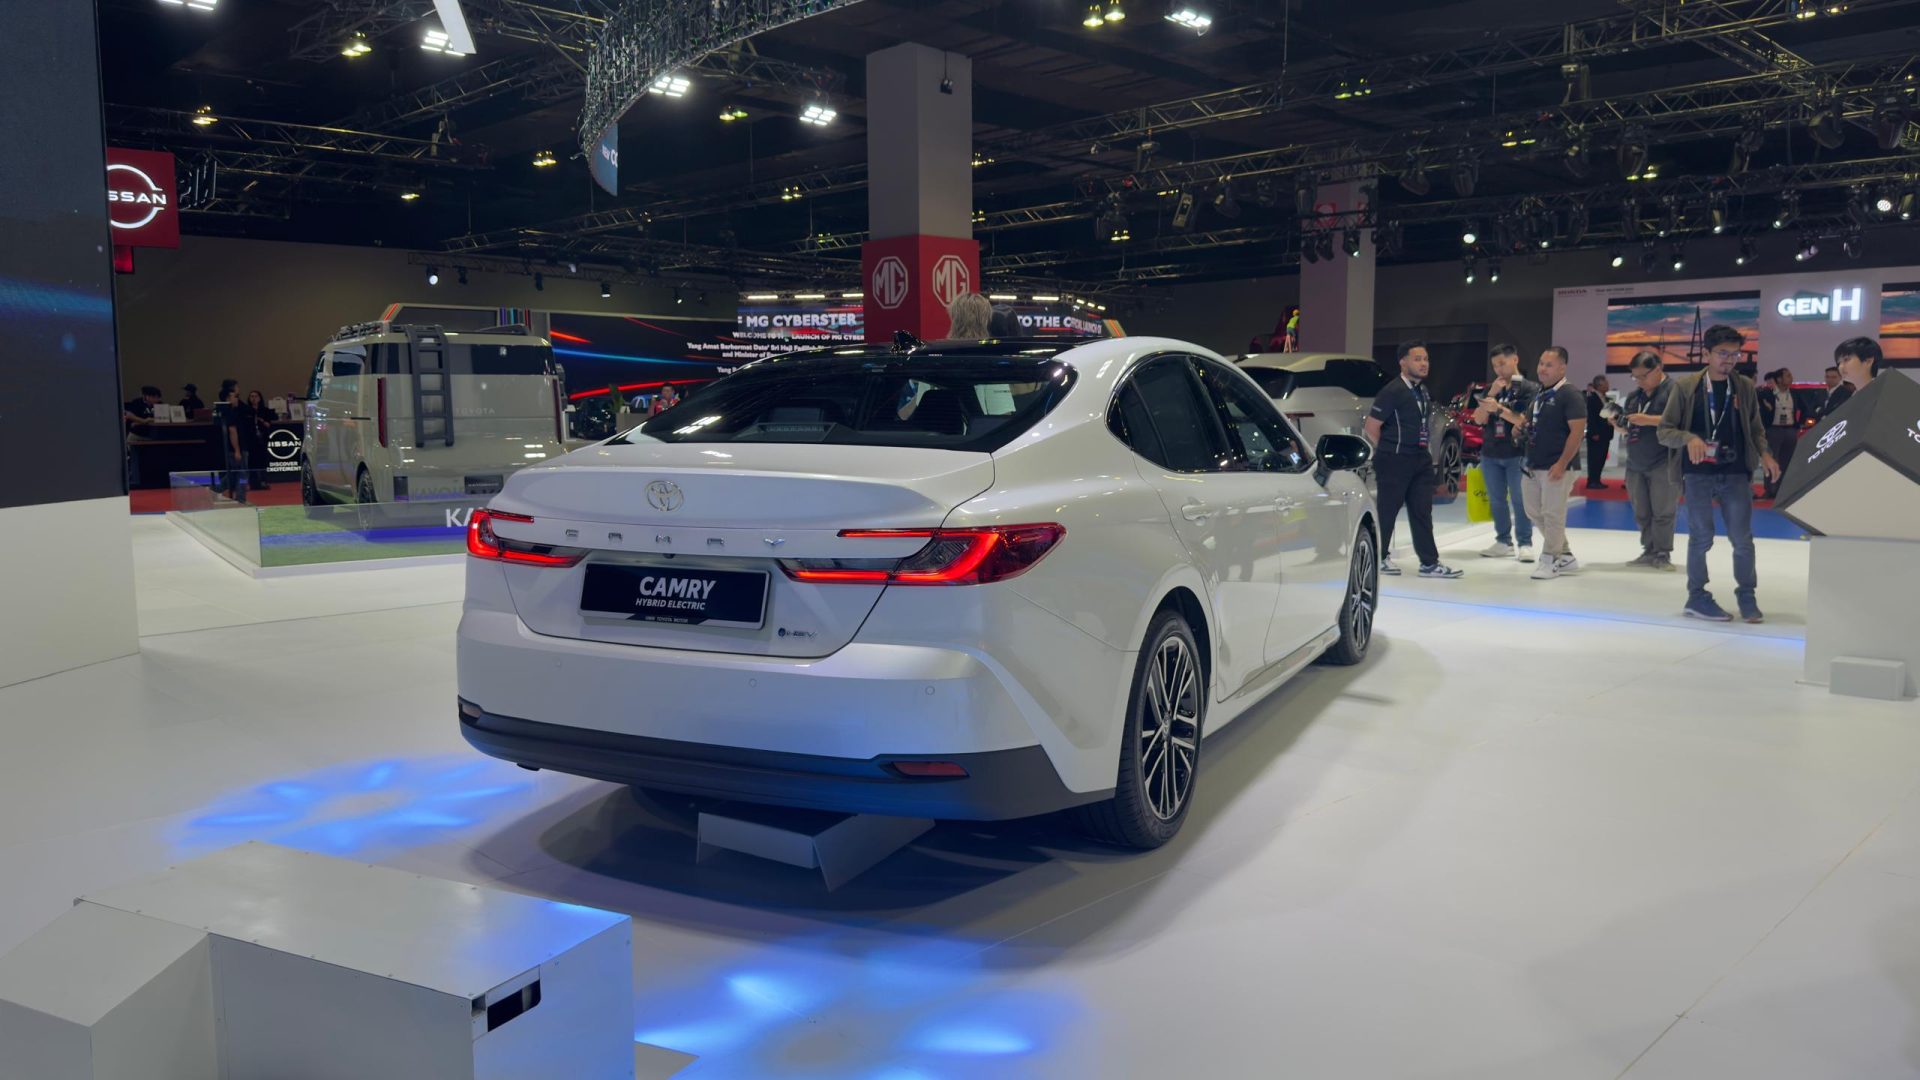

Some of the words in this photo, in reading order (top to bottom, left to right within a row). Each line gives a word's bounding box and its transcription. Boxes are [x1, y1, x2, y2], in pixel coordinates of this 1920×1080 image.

[1777, 297, 1829, 316] GEN
[1832, 287, 1861, 321] H
[746, 315, 769, 328] MG
[773, 312, 857, 327] CYBERSTER
[1034, 315, 1060, 328] THE
[639, 576, 717, 600] CAMRY
[635, 597, 667, 609] HYBRID
[667, 599, 706, 611] ELECTRIC
